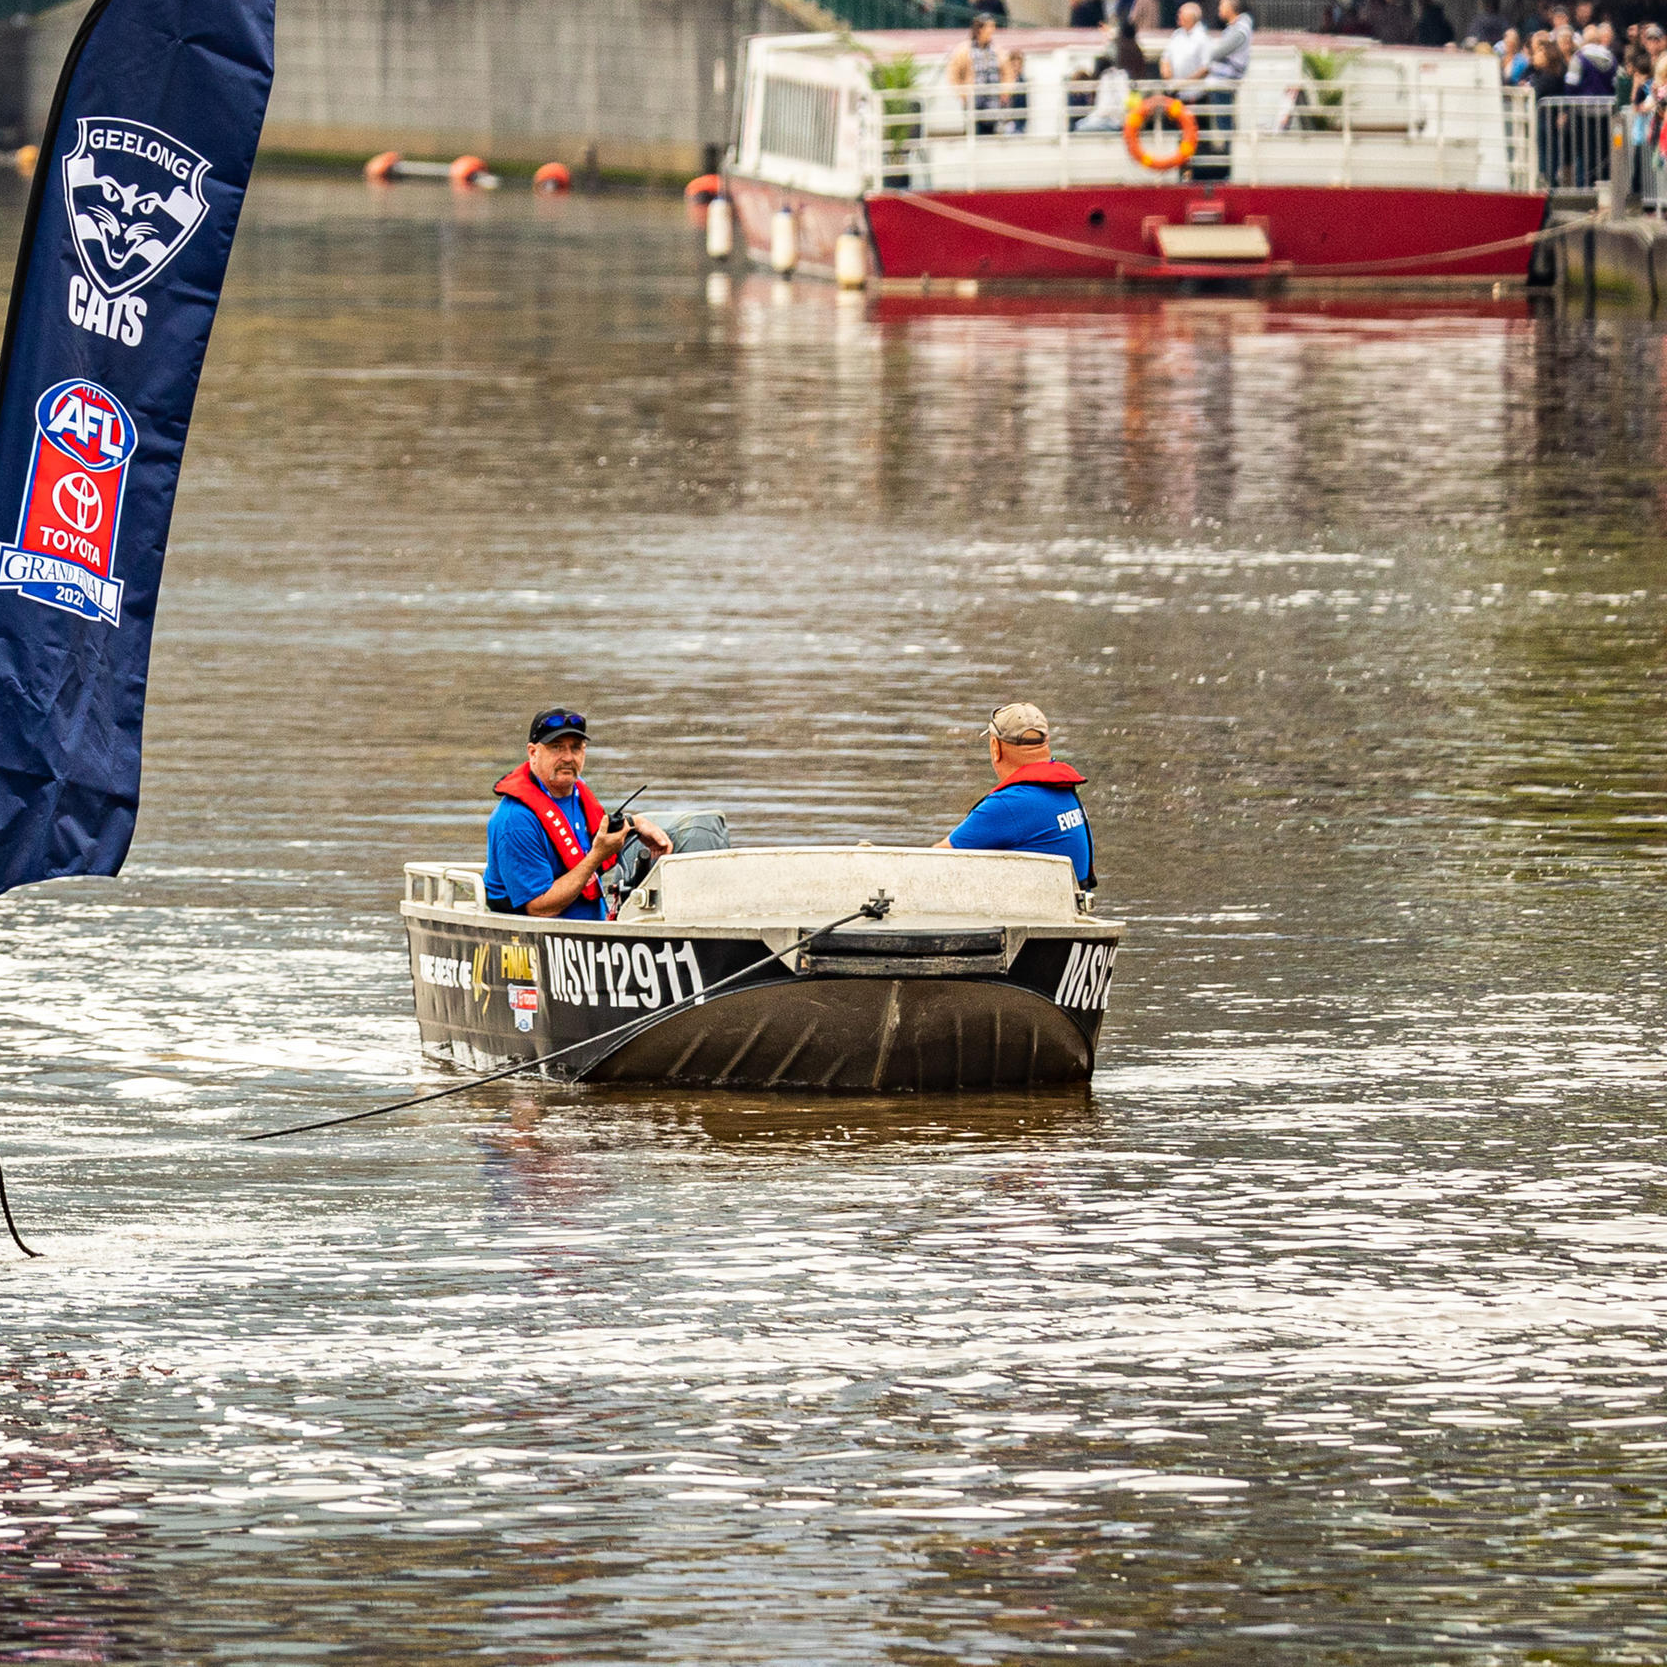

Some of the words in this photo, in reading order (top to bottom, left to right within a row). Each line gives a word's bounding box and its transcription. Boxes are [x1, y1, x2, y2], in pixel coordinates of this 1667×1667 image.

[89, 128, 193, 181] GEELONG
[68, 274, 148, 348] CATS
[46, 393, 124, 460] AFL
[39, 525, 101, 567] TOYOTA
[4, 553, 75, 582] GRAND
[77, 567, 116, 612] FINAL
[55, 585, 85, 609] 2022
[458, 960, 473, 991] OF
[501, 944, 539, 987] FINALS
[545, 935, 705, 1009] MSV12911
